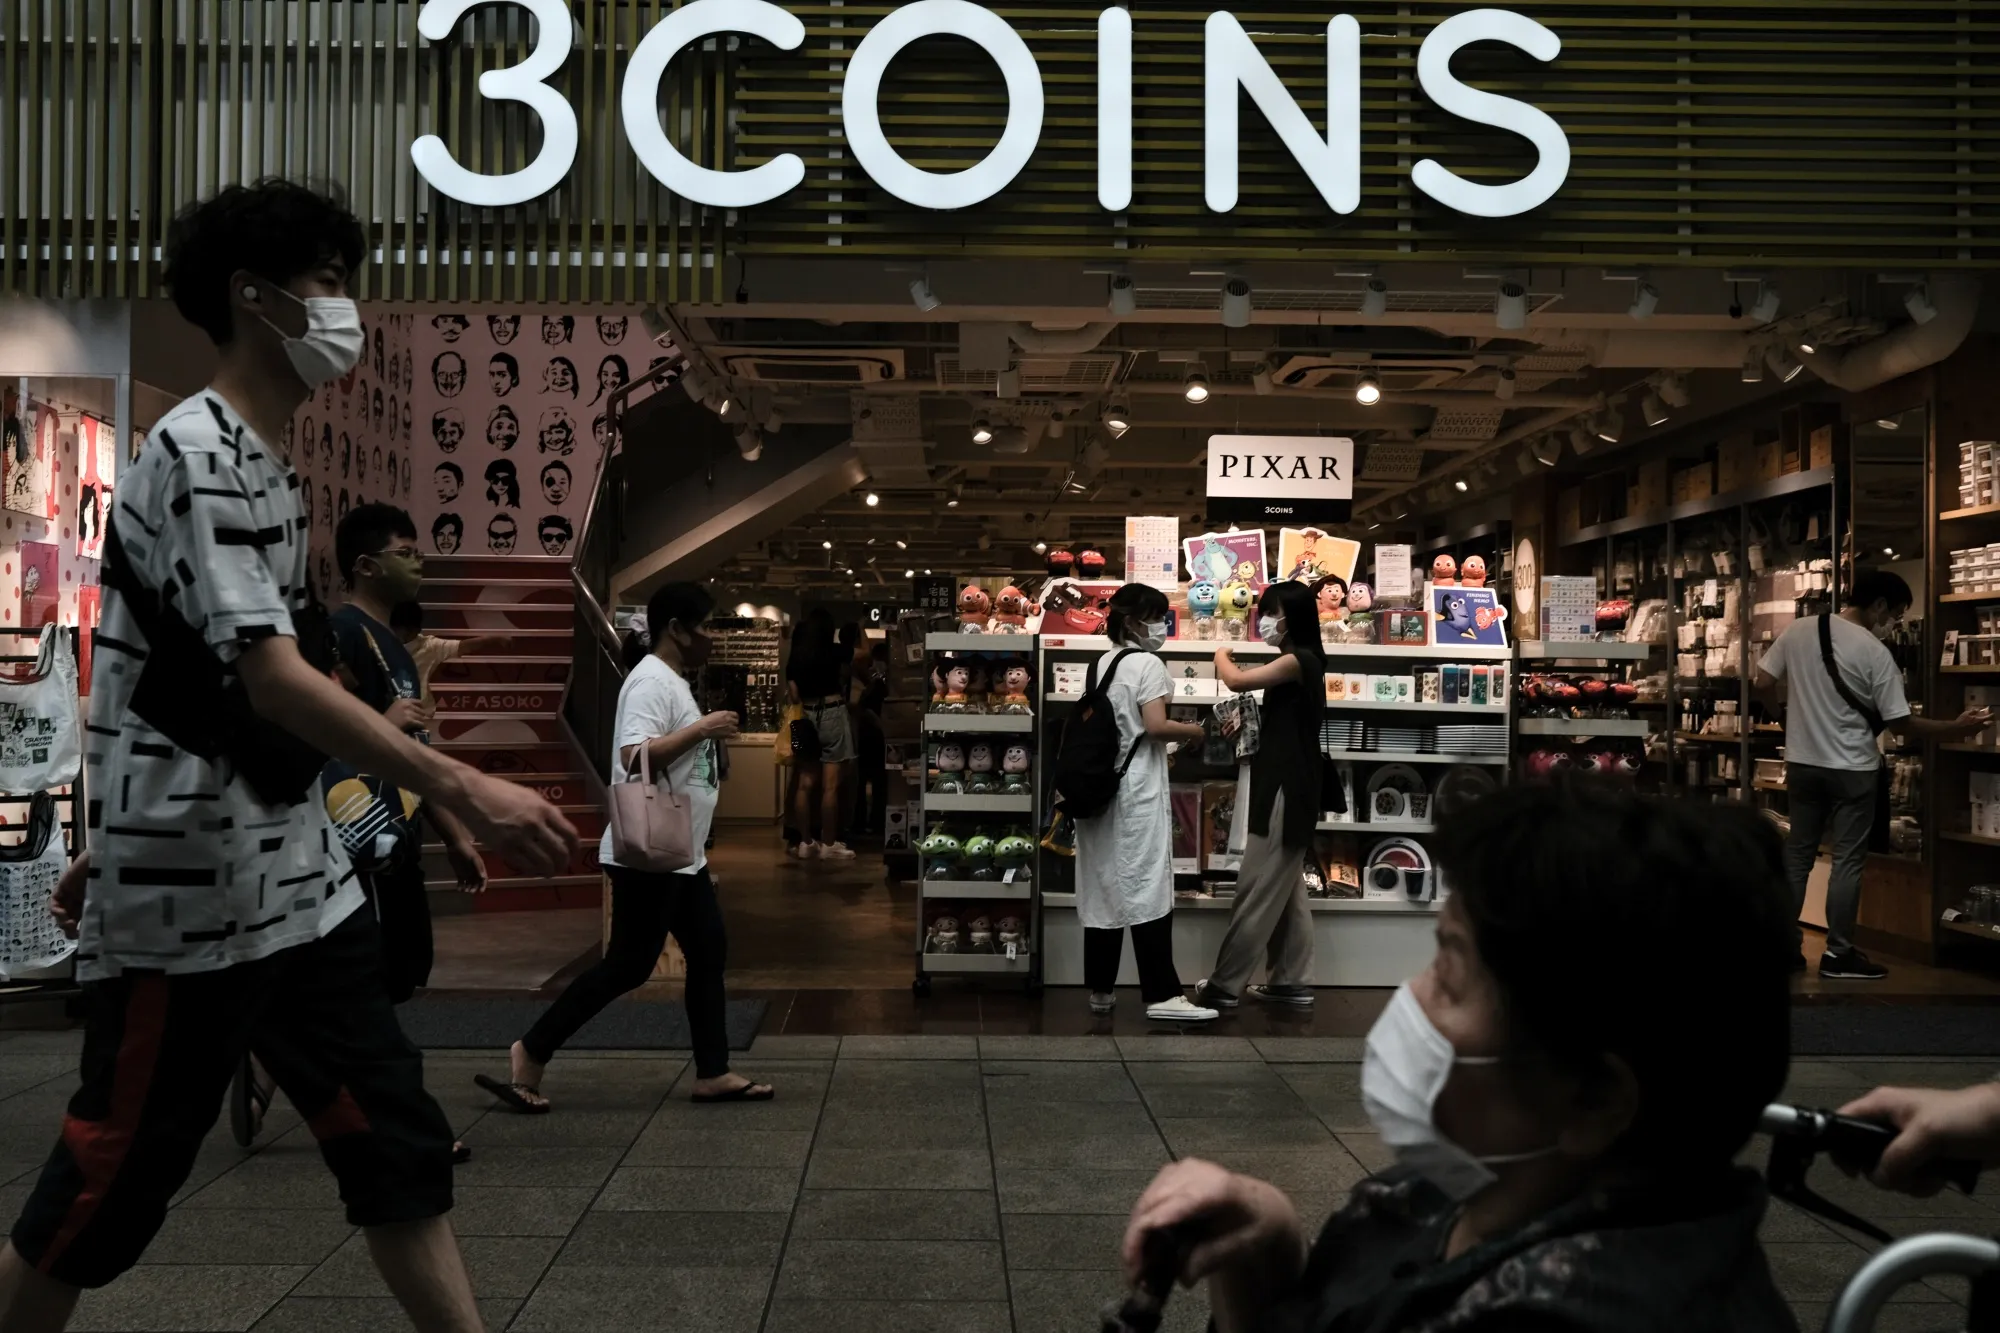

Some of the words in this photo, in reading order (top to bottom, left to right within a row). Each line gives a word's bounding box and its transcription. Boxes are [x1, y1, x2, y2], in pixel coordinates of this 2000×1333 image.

[411, 0, 1569, 217] 3COINS
[1219, 454, 1341, 480] PIXAR
[1264, 506, 1294, 514] 3COINS
[451, 696, 471, 709] 2F
[475, 695, 543, 709] ASOKO
